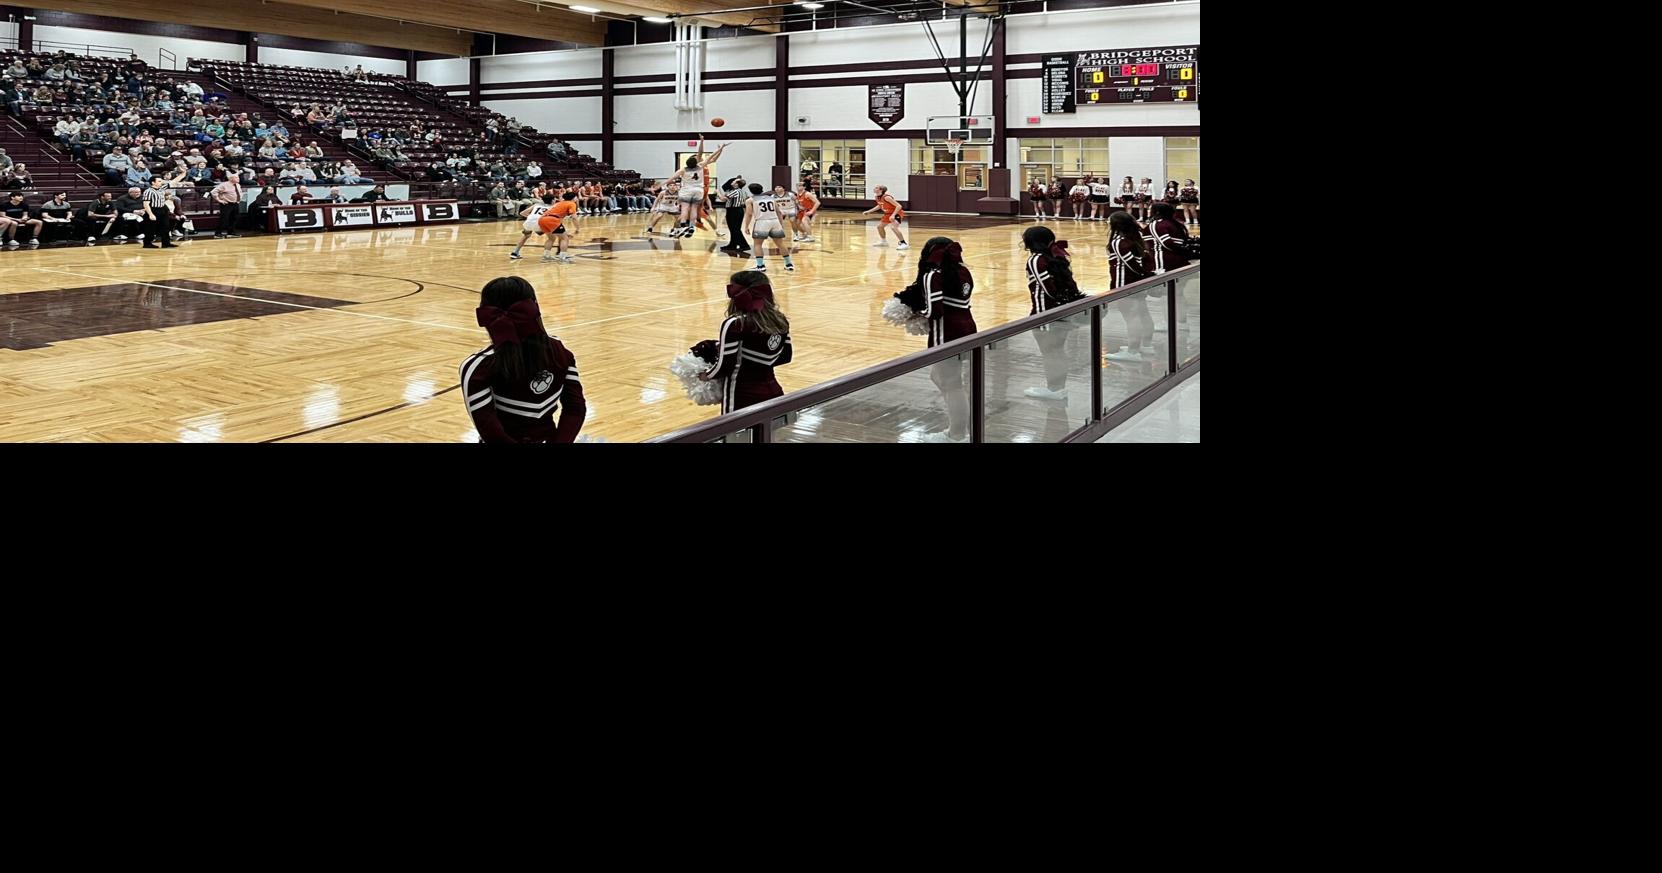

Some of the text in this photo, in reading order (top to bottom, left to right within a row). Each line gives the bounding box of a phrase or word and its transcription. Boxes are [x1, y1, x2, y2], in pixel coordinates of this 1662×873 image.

[1091, 48, 1196, 59] BRIDGEPORT
[1136, 55, 1196, 63] SCHOOL
[1093, 71, 1104, 83] 0
[1181, 68, 1192, 80] 0
[426, 204, 454, 219] B
[534, 207, 548, 216] 13
[758, 201, 775, 213] 30
[283, 209, 317, 227] B
